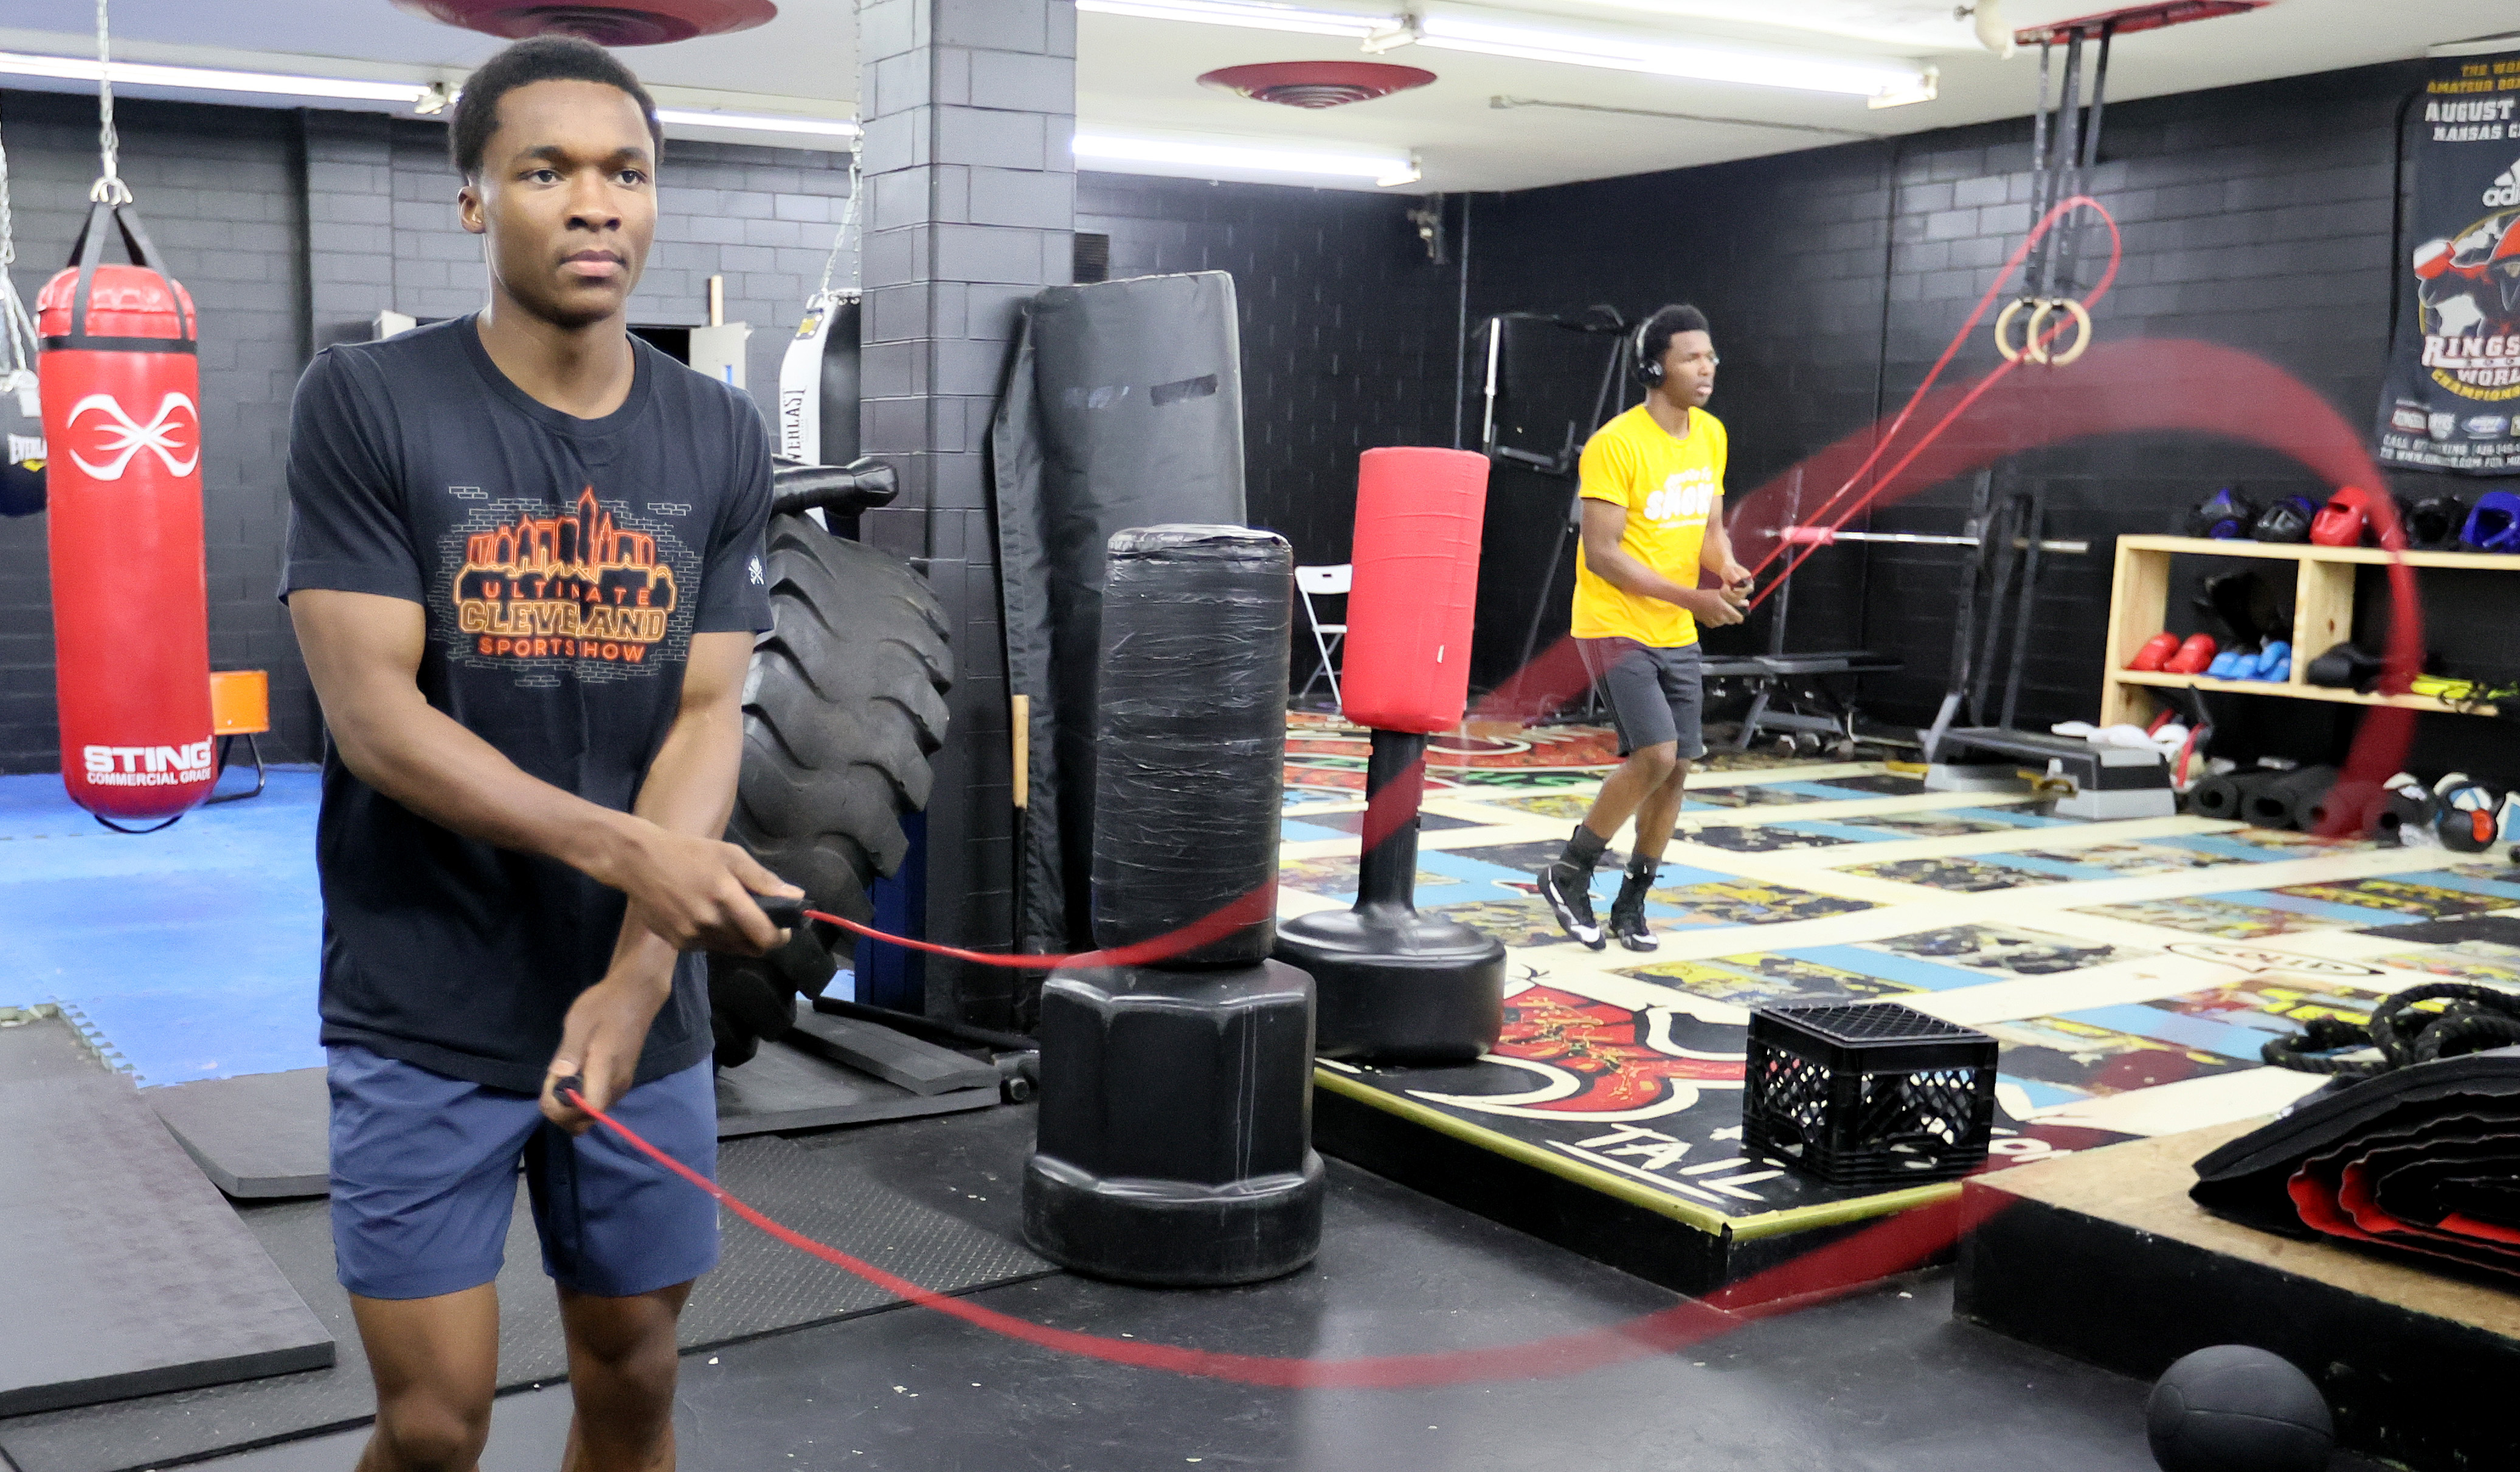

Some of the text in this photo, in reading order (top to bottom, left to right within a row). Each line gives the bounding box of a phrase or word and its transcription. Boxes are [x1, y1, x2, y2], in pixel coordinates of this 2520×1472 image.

[2425, 98, 2515, 122] AUGUST
[2433, 123, 2502, 141] KANSAS
[459, 599, 669, 643] CLEVEAND
[84, 742, 212, 773] STING
[87, 772, 178, 786] COMMERCIAL
